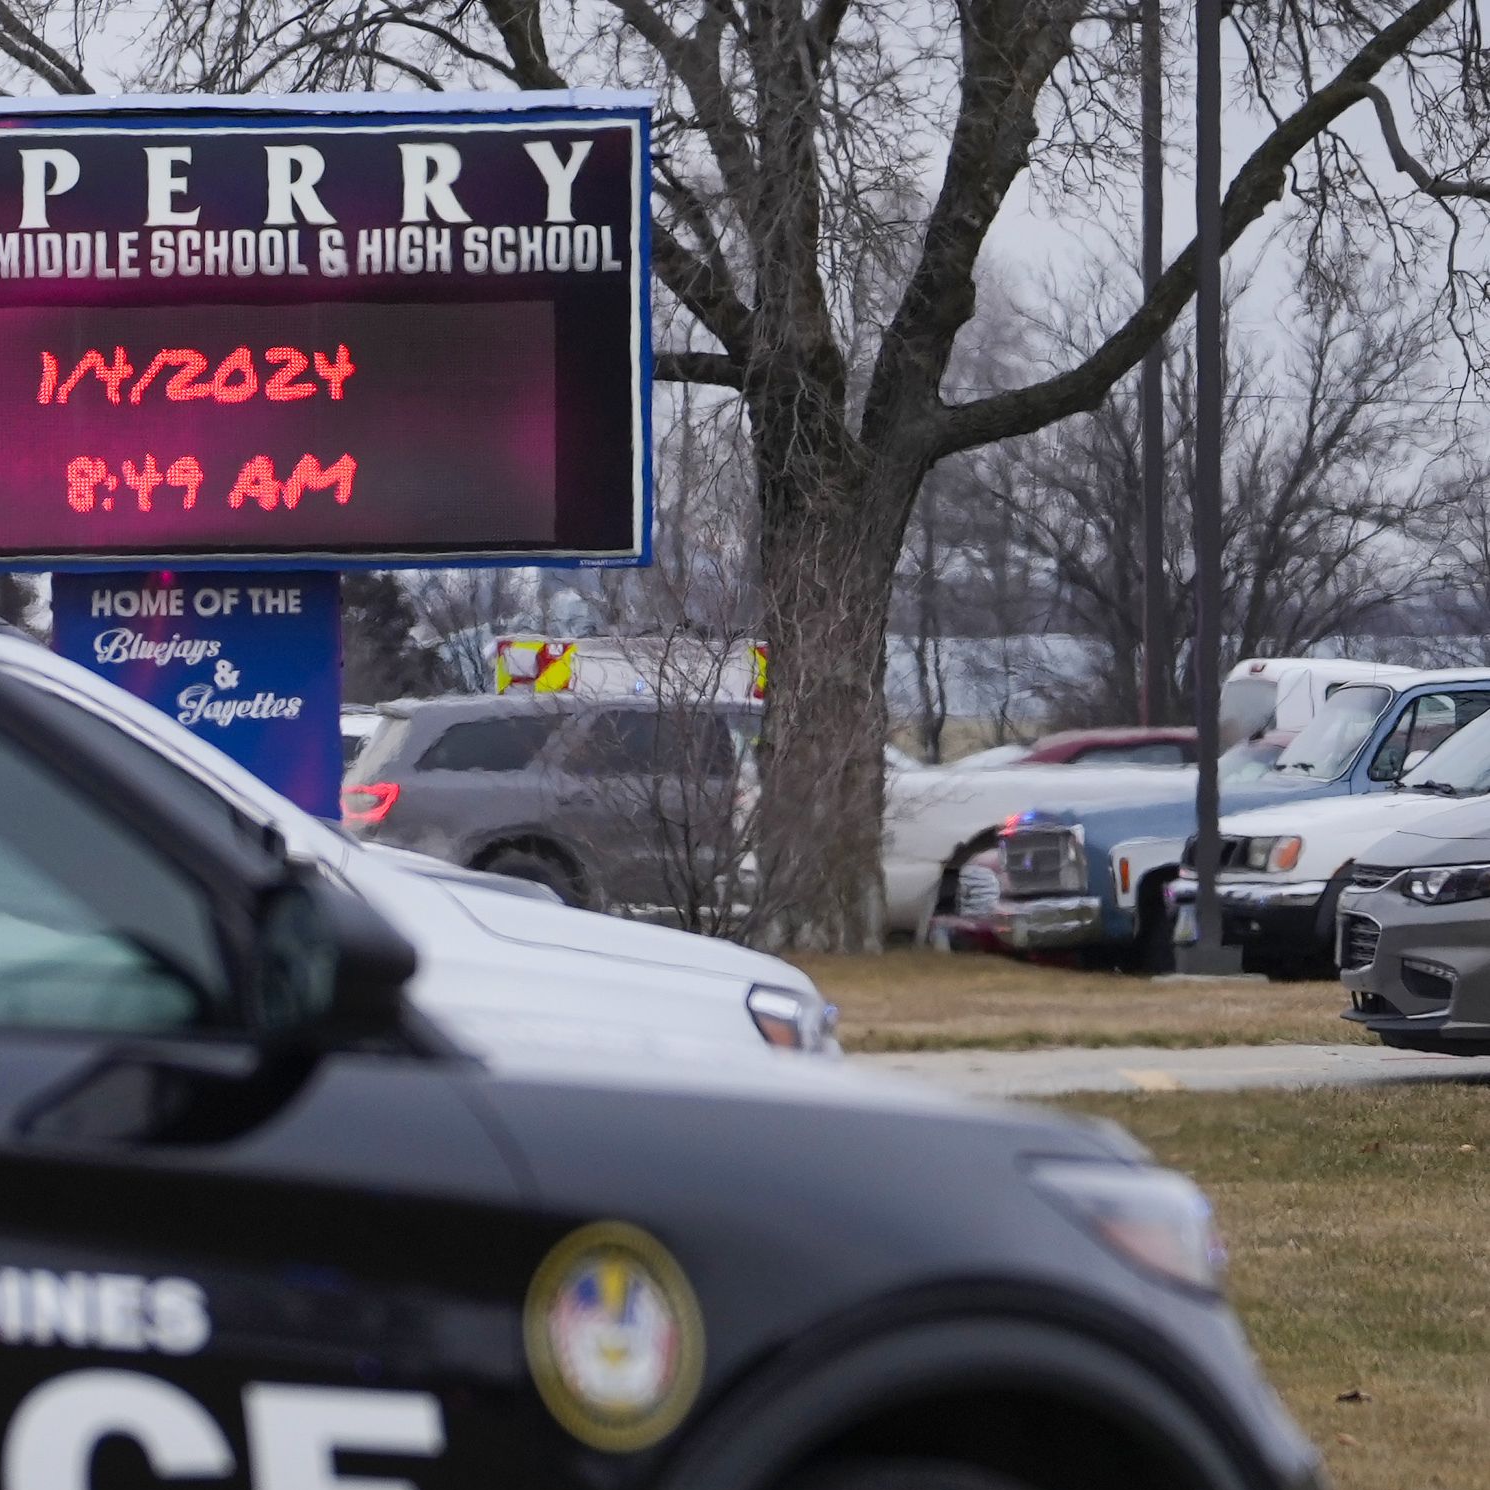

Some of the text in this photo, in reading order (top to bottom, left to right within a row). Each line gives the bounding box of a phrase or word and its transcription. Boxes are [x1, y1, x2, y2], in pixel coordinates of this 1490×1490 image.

[18, 140, 594, 229] PERRY
[150, 229, 309, 277] SCHOOL
[319, 227, 348, 277] &
[357, 225, 452, 275] HIGH
[463, 224, 622, 274] SCHOOL
[36, 343, 356, 406] 1/4/2024
[67, 452, 358, 513] 8:49 AM
[91, 588, 302, 618] HOME OF THE
[93, 627, 222, 666] Bluejays
[214, 659, 241, 690] &
